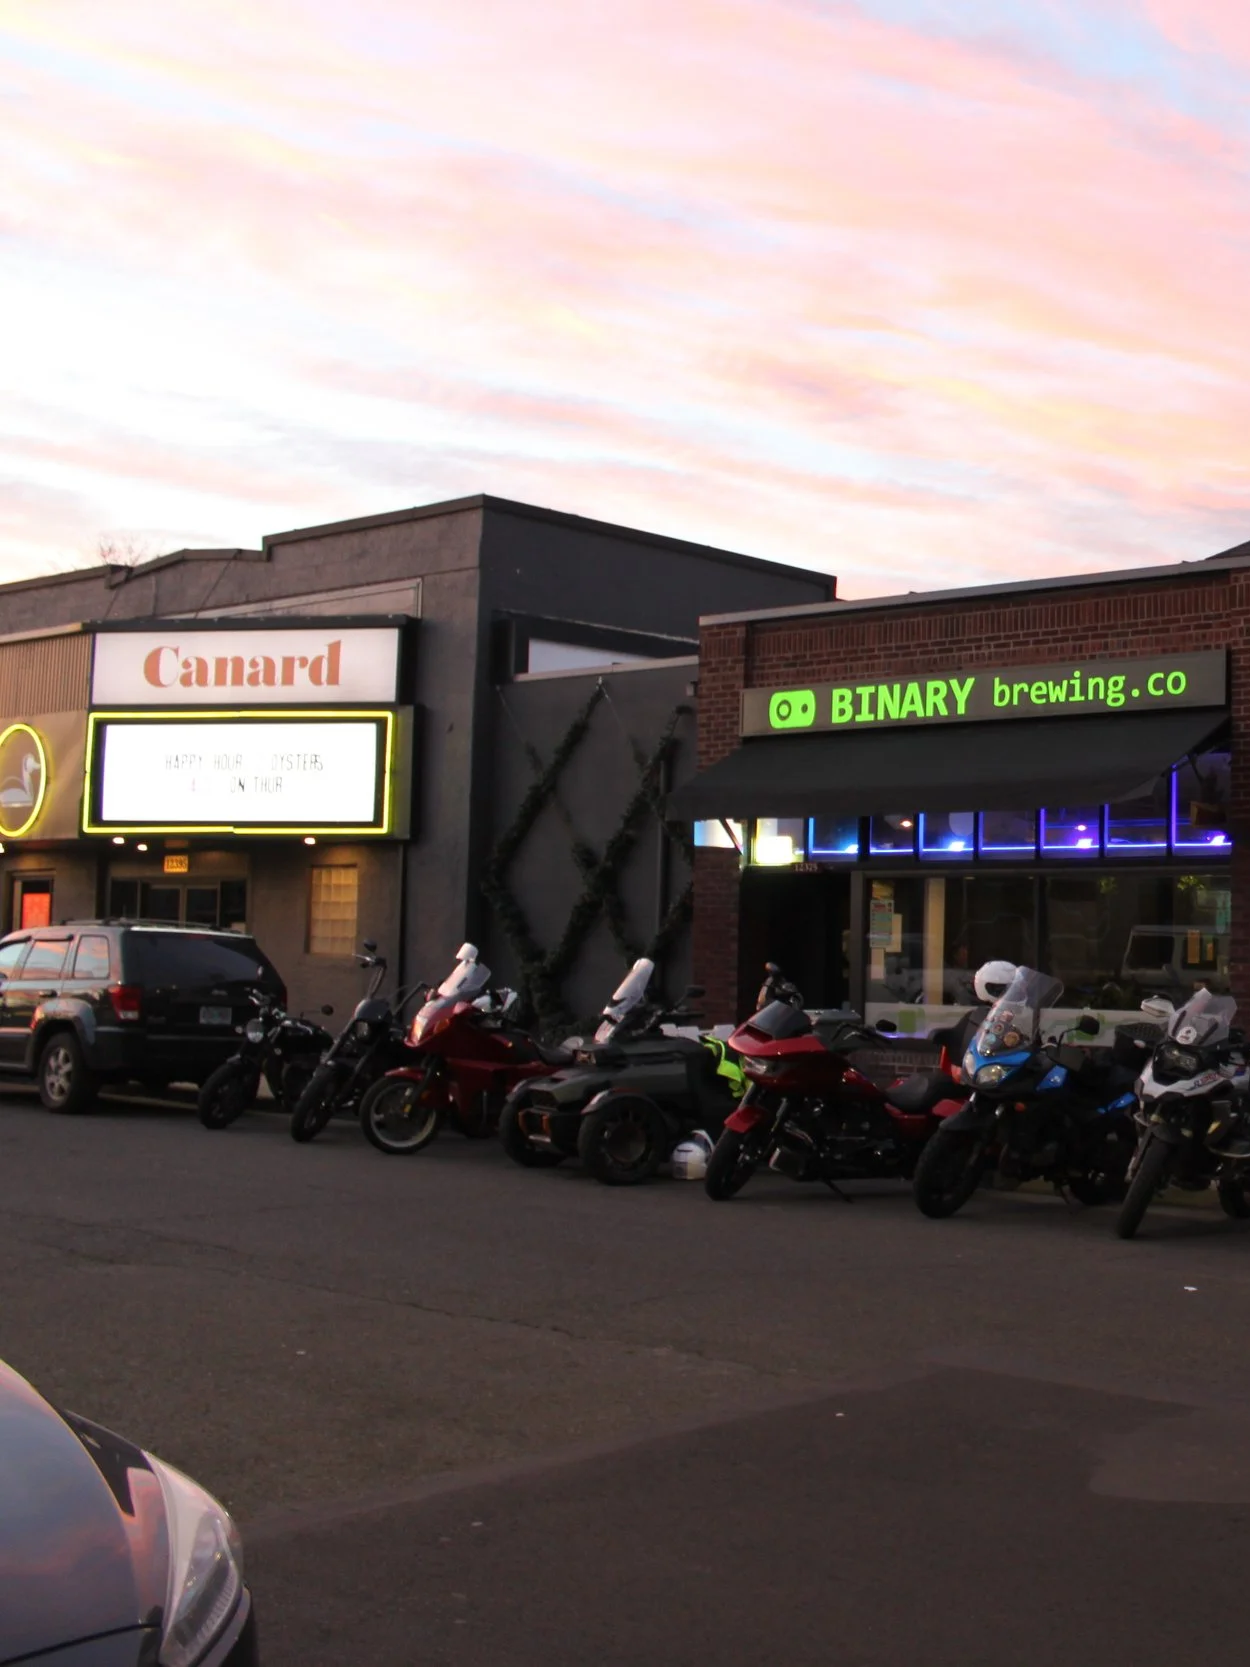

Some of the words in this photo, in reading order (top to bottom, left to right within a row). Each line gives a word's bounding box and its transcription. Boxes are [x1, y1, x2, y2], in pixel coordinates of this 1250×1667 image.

[143, 639, 342, 688] Canard
[831, 677, 975, 724] BINARY
[993, 670, 1187, 707] brewing.co
[165, 753, 202, 771] HAPPY
[213, 753, 243, 772] HOUR
[271, 753, 324, 772] OYSTERS
[230, 775, 246, 794] ON
[253, 775, 283, 794] THUR
